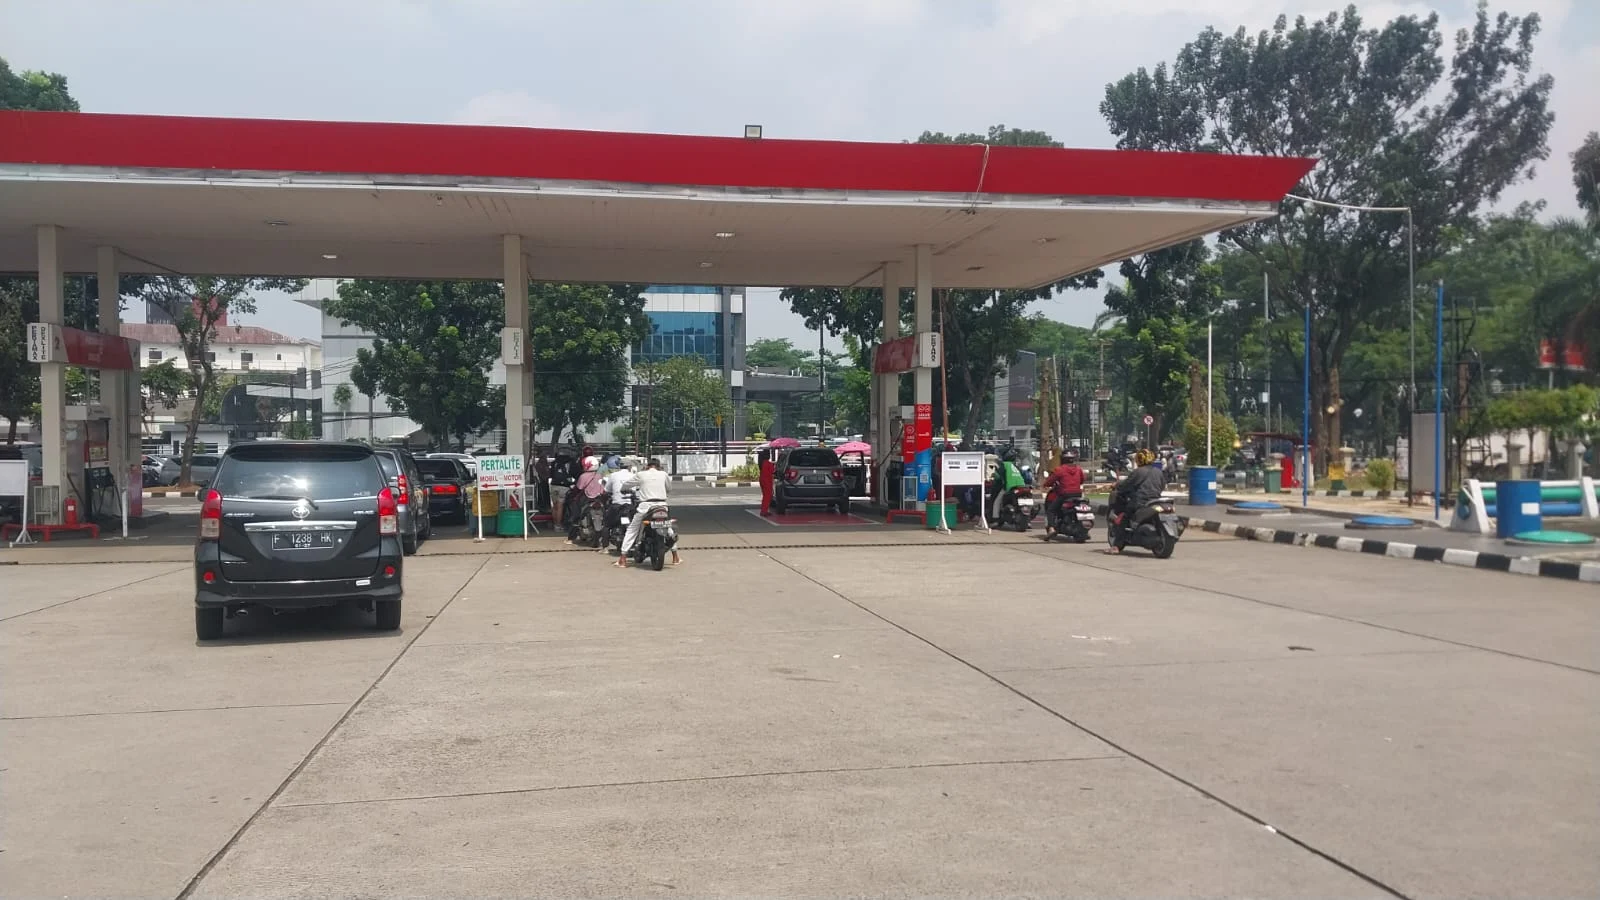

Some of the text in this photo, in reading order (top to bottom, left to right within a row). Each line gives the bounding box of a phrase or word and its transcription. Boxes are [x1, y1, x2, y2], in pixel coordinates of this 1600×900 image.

[480, 458, 521, 471] PERTALITE
[274, 532, 332, 544] F 1238 HK
